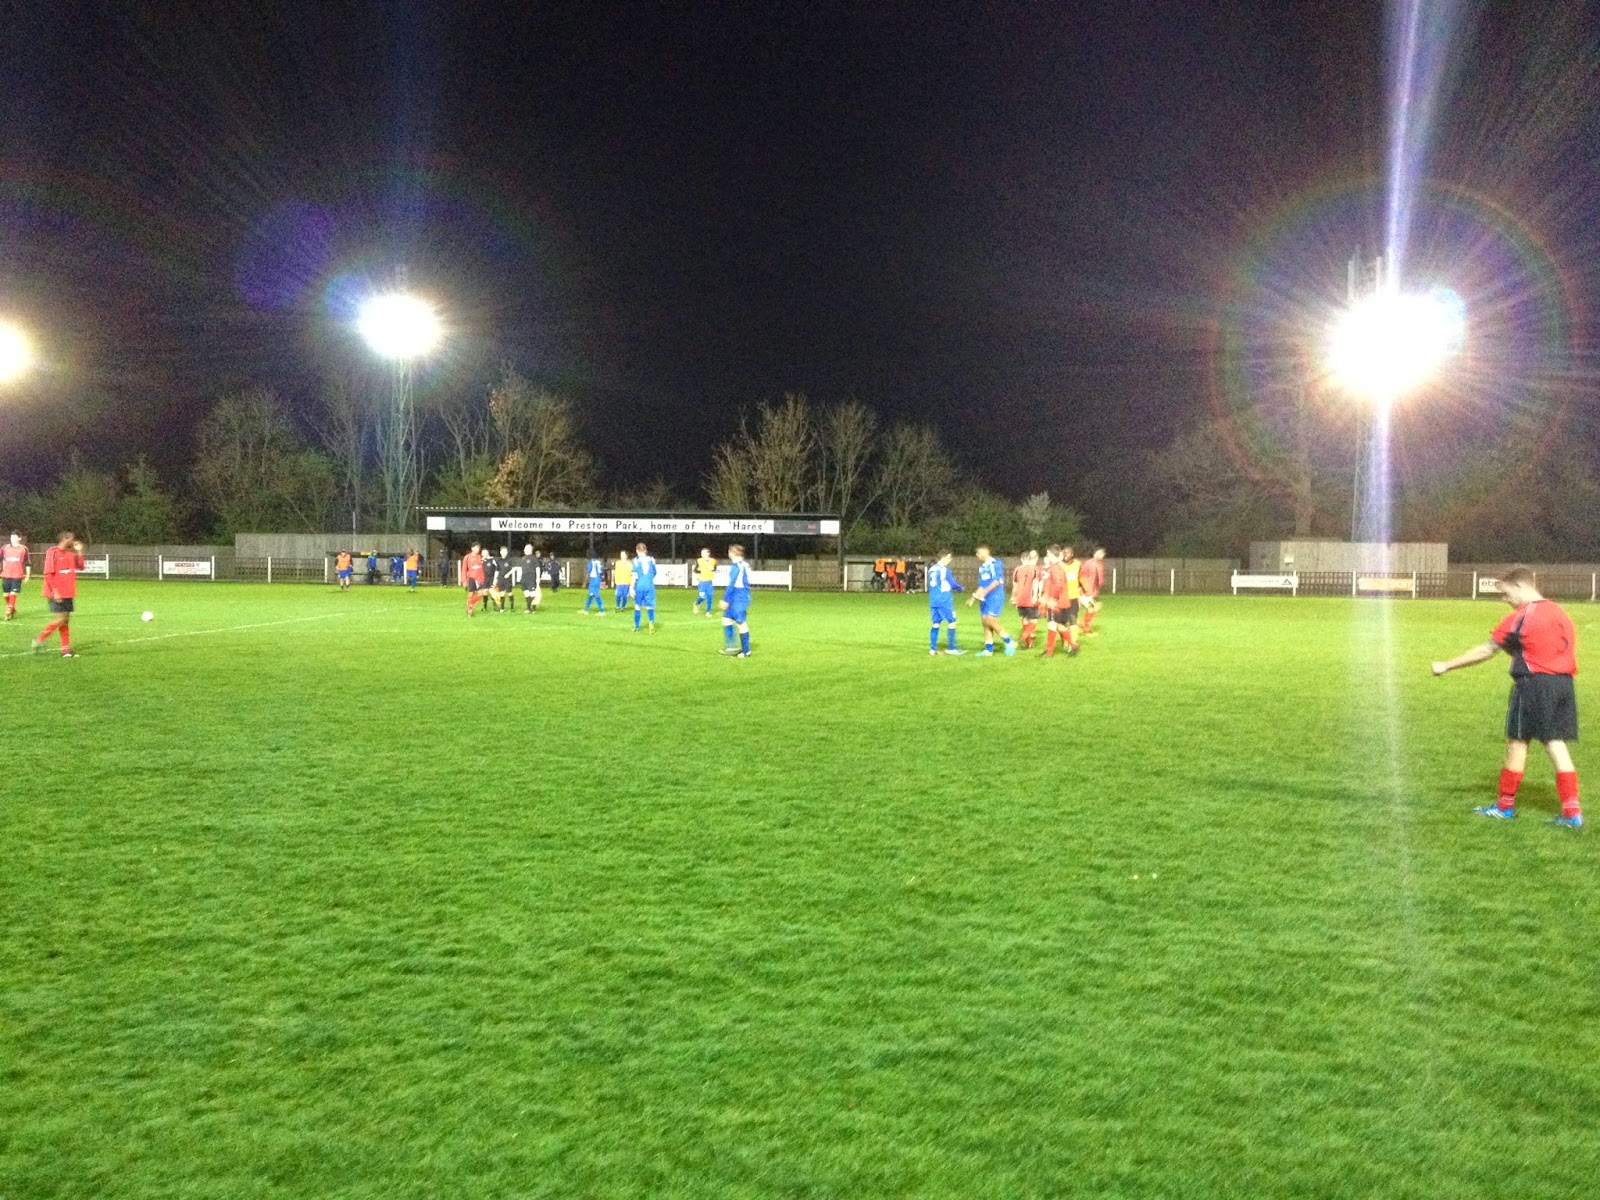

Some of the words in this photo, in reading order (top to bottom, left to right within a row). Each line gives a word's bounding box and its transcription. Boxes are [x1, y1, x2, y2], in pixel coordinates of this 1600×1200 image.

[499, 519, 543, 529] Welcome
[551, 521, 561, 529] to
[568, 520, 608, 530] Preston
[615, 520, 643, 531] Park,
[650, 521, 677, 530] home
[684, 521, 696, 530] of
[704, 521, 720, 530] the
